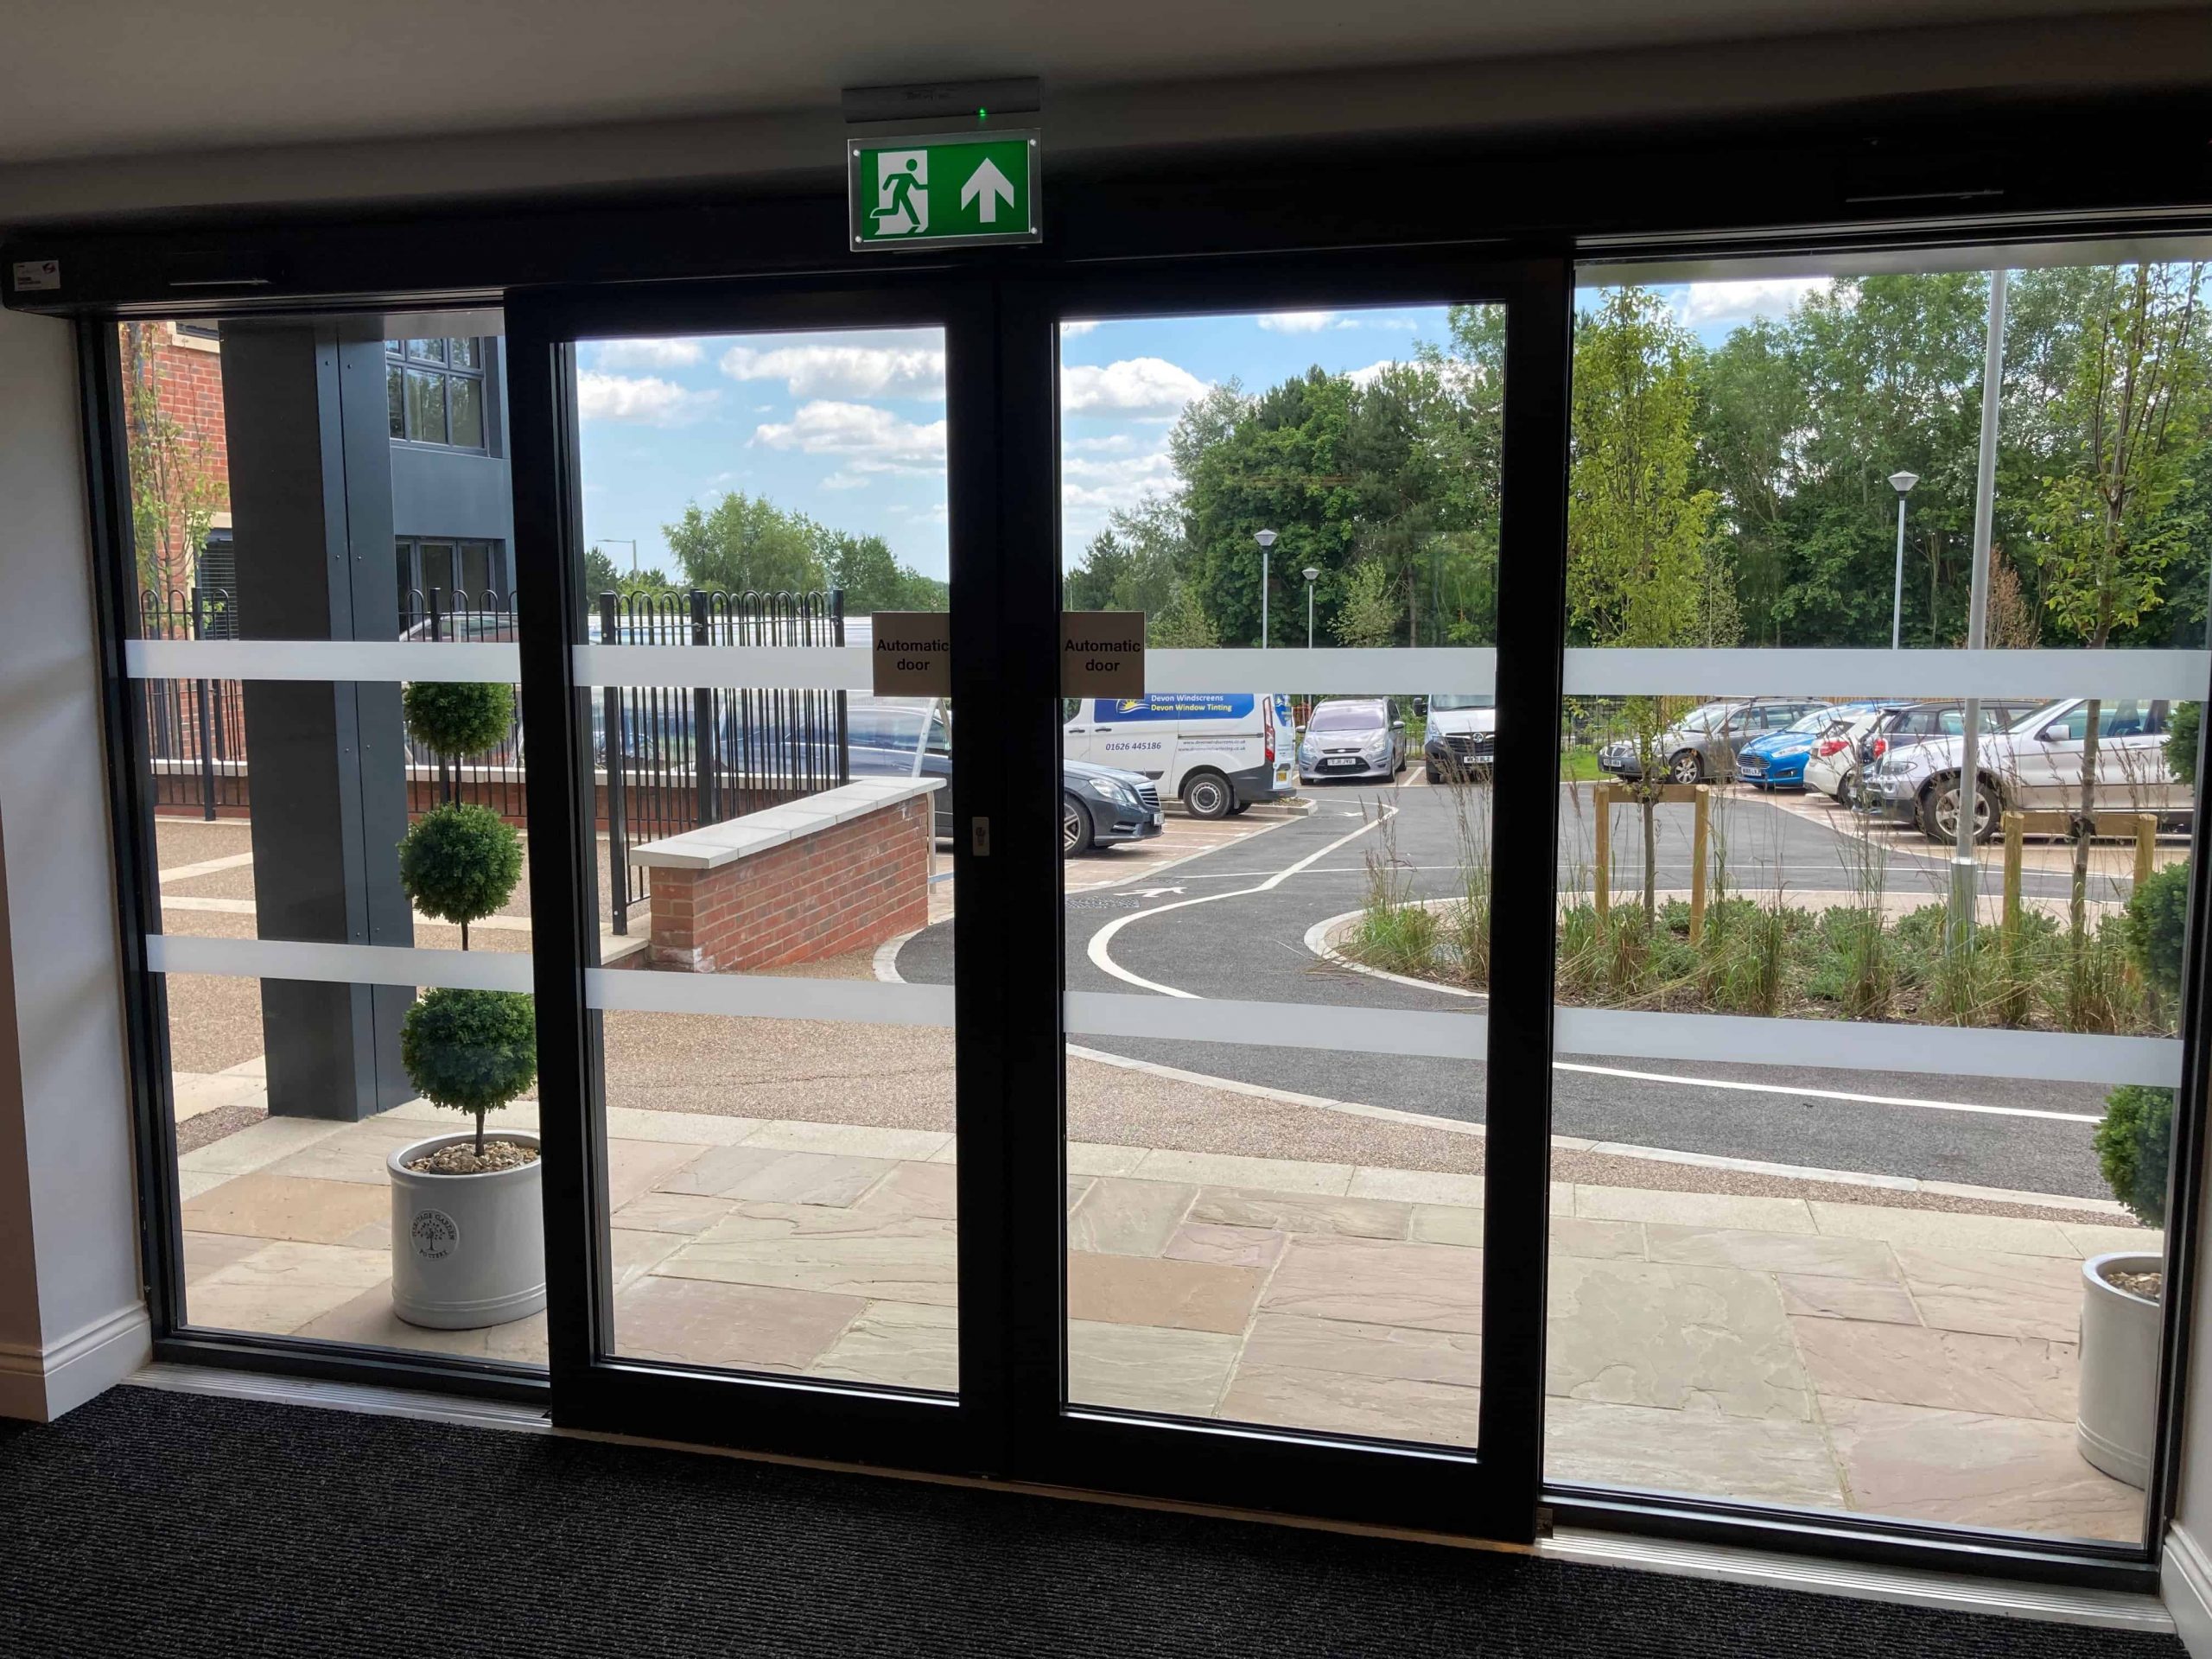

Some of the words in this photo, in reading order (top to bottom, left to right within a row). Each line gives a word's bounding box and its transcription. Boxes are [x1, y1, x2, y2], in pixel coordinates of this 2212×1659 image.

[876, 639, 949, 652] Automatic
[1065, 639, 1141, 652] Automatic
[897, 658, 931, 671] door
[1085, 658, 1121, 671] door
[1207, 703, 1232, 712] Tinting
[1105, 742, 1130, 751] 01626
[1131, 741, 1162, 750] 445186
